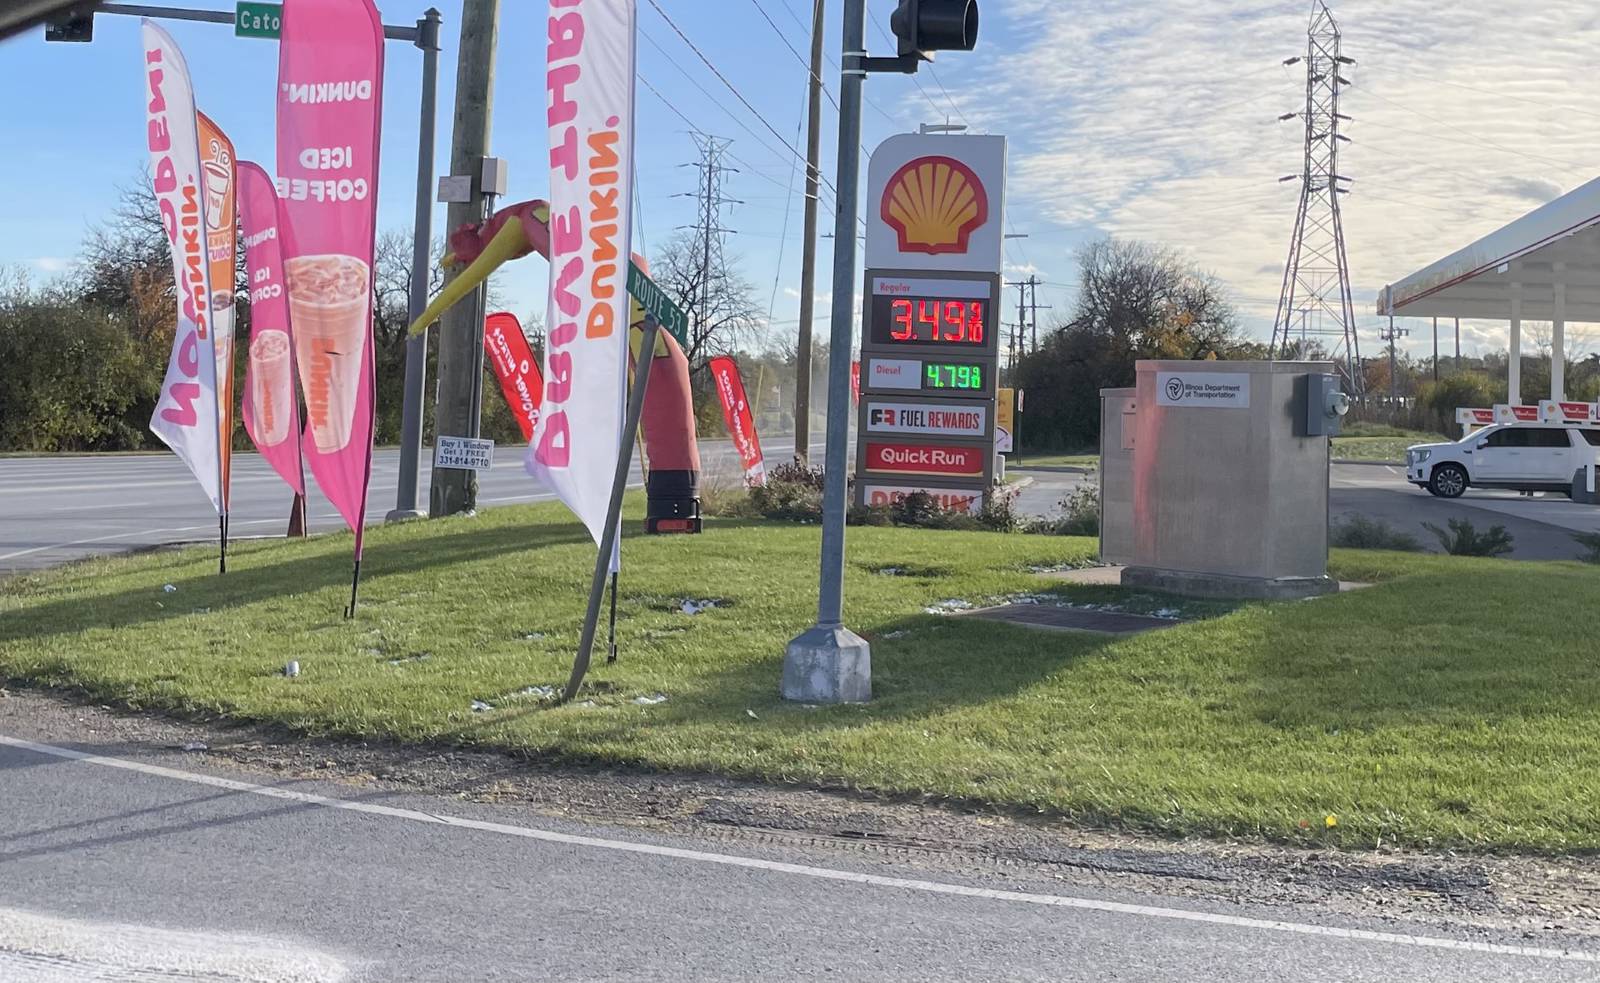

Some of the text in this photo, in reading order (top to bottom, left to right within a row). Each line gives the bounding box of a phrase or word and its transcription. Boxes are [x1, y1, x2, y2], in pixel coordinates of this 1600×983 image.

[880, 283, 911, 293] Regular
[634, 272, 682, 336] ROUTE 53
[876, 365, 902, 376] Diesel
[1205, 384, 1240, 392] Department
[1193, 391, 1236, 399] Transportation
[900, 410, 926, 428] FUEL
[928, 411, 980, 430] REWARDS
[441, 440, 456, 449] Buy
[464, 441, 490, 450] Window
[466, 450, 486, 458] FREE
